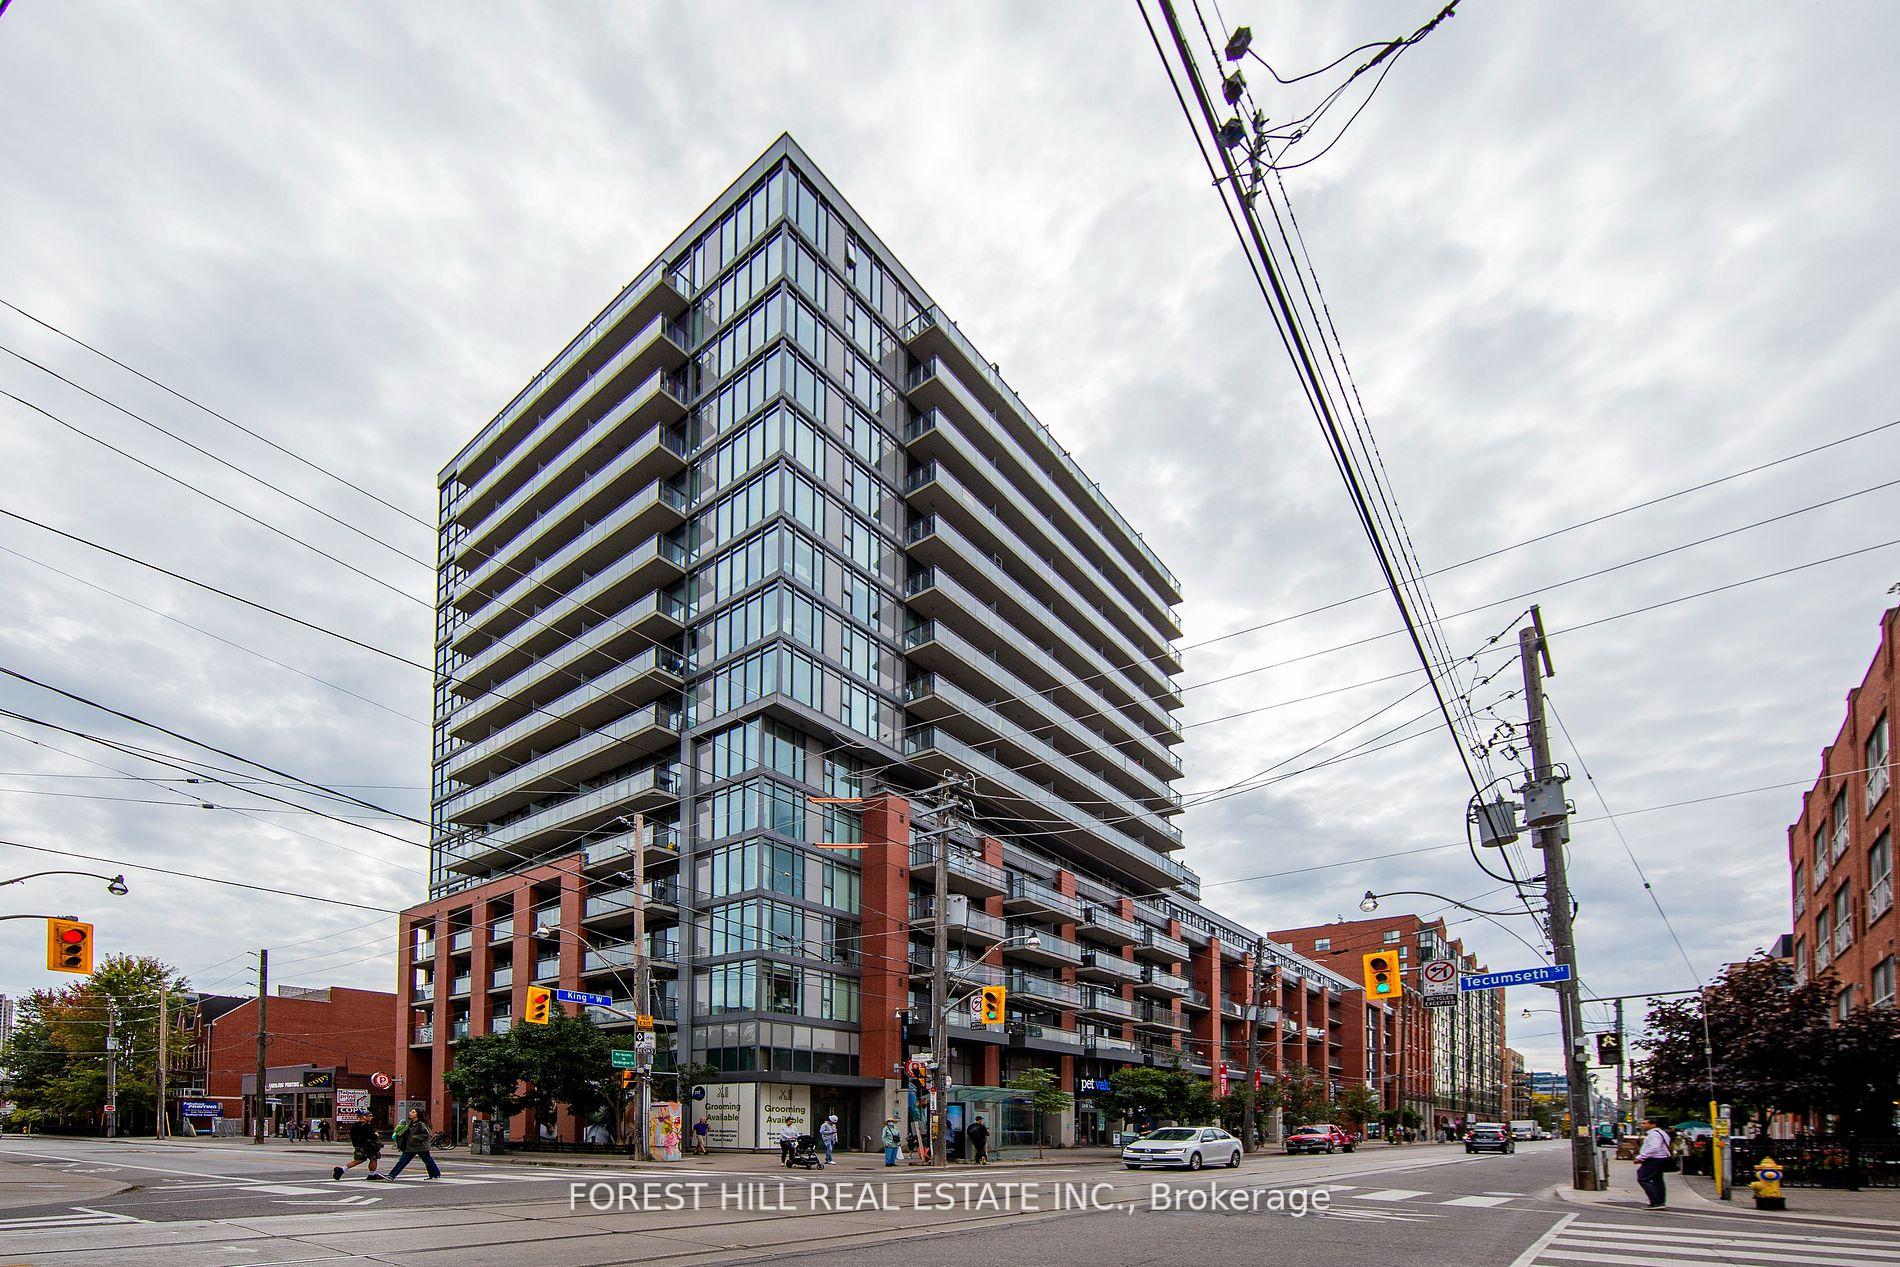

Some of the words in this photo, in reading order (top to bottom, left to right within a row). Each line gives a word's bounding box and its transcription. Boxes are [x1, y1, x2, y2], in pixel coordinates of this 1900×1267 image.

[1465, 969, 1549, 987] Tecumseth
[567, 991, 587, 1003] King
[1081, 1078, 1095, 1091] pet
[705, 1103, 741, 1111] Grooming
[764, 1105, 806, 1115] Grooming
[708, 1113, 739, 1121] Available
[766, 1116, 804, 1124] Availble
